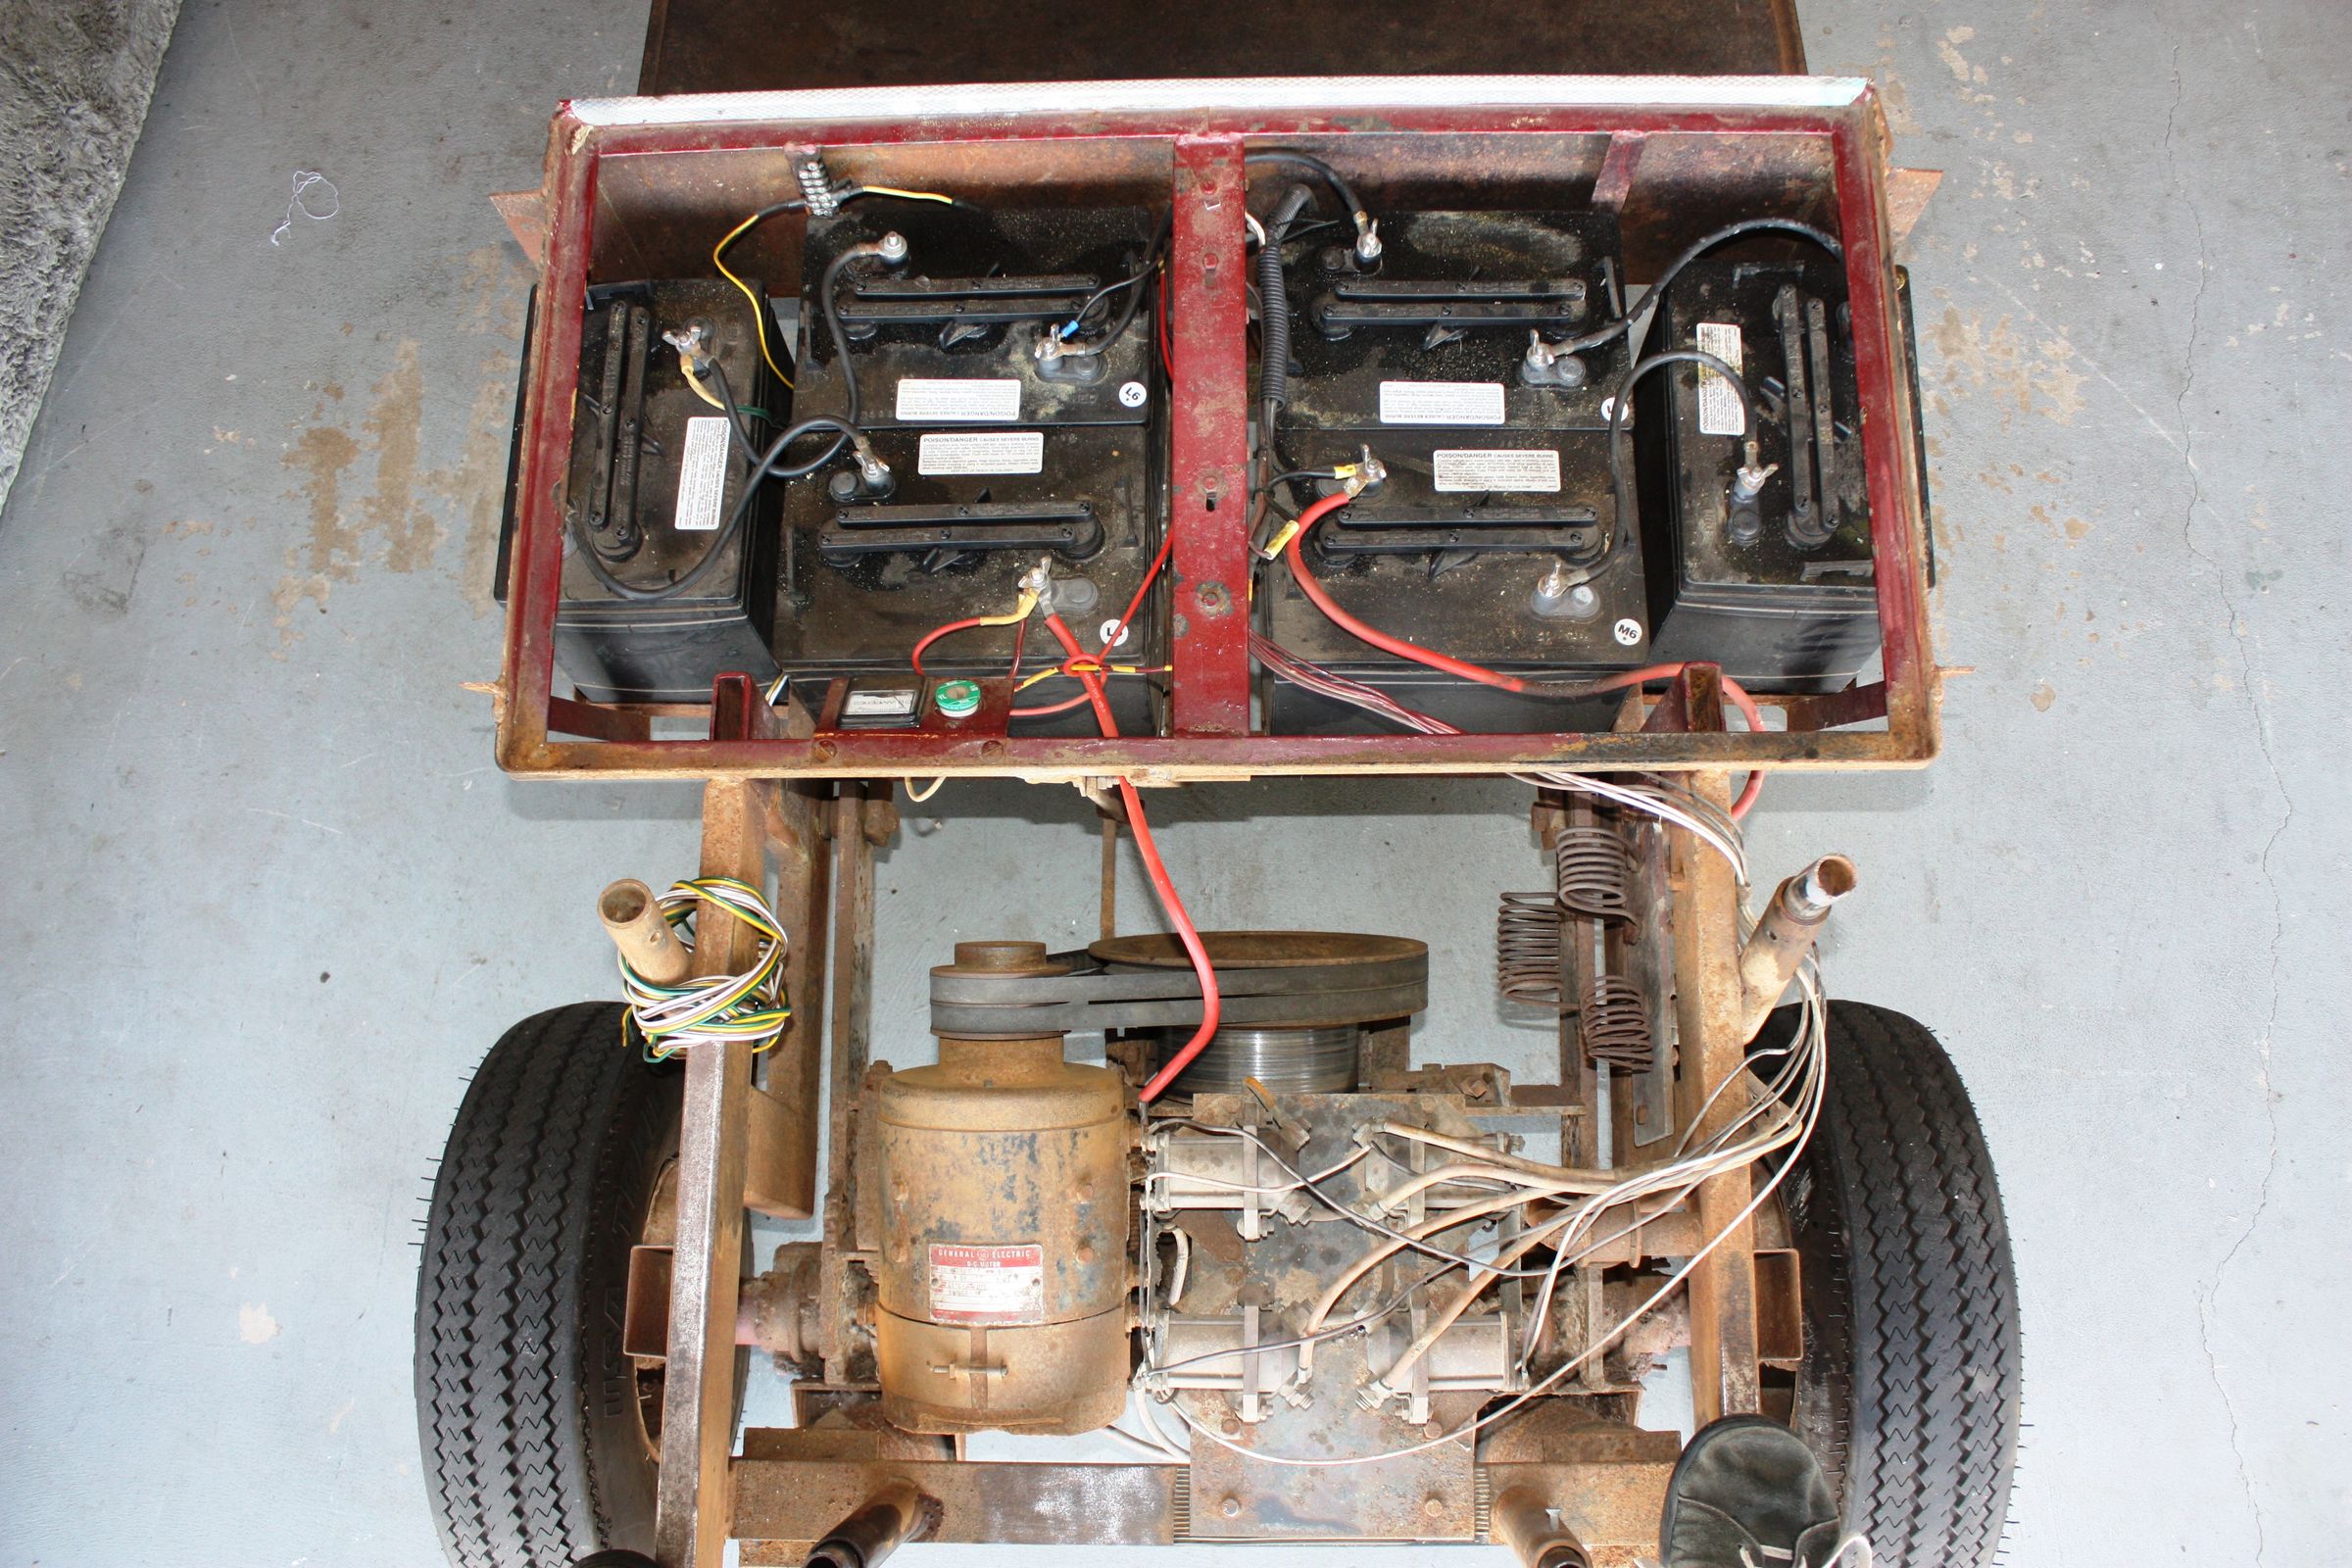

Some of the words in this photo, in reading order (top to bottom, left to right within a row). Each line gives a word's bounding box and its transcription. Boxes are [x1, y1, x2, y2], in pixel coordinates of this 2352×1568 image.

[1618, 624, 1638, 639] M6
[938, 1249, 975, 1258] GENERAL
[992, 1250, 1031, 1259] ELECTRIC
